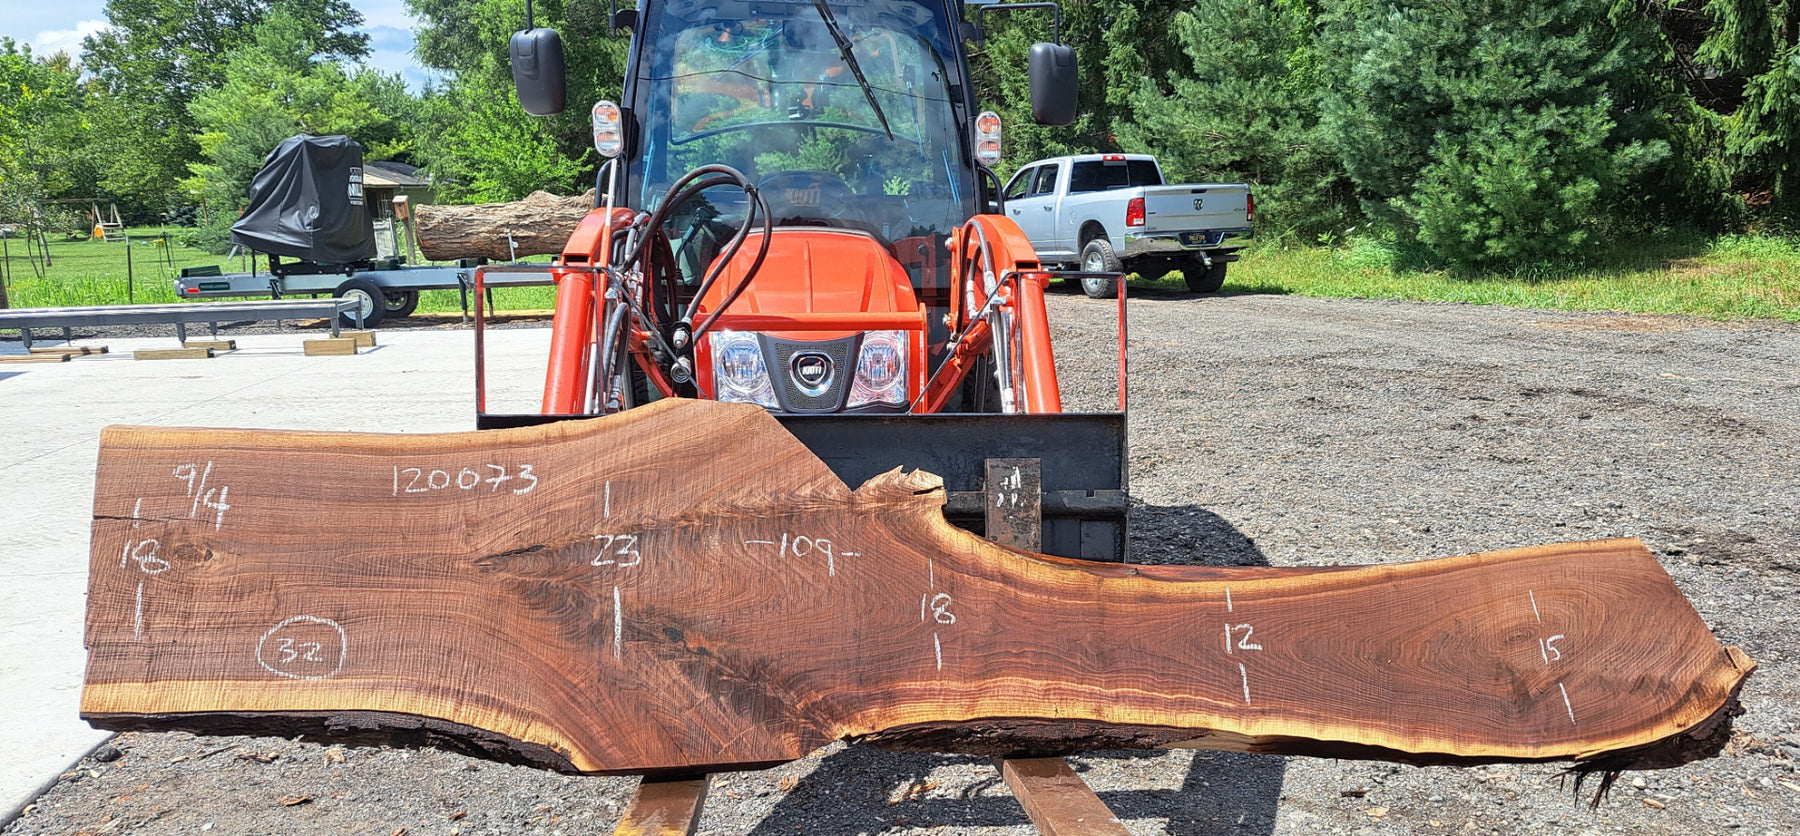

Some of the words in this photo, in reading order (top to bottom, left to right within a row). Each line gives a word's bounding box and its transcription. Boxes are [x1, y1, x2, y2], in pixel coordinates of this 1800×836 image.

[802, 365, 822, 375] KIOTI
[393, 464, 538, 496] 120073
[120, 539, 171, 574] 18
[590, 534, 641, 567] 23
[921, 592, 956, 624] 18
[277, 636, 322, 663] 32
[1225, 622, 1263, 654] 12
[1538, 633, 1565, 665] 15
